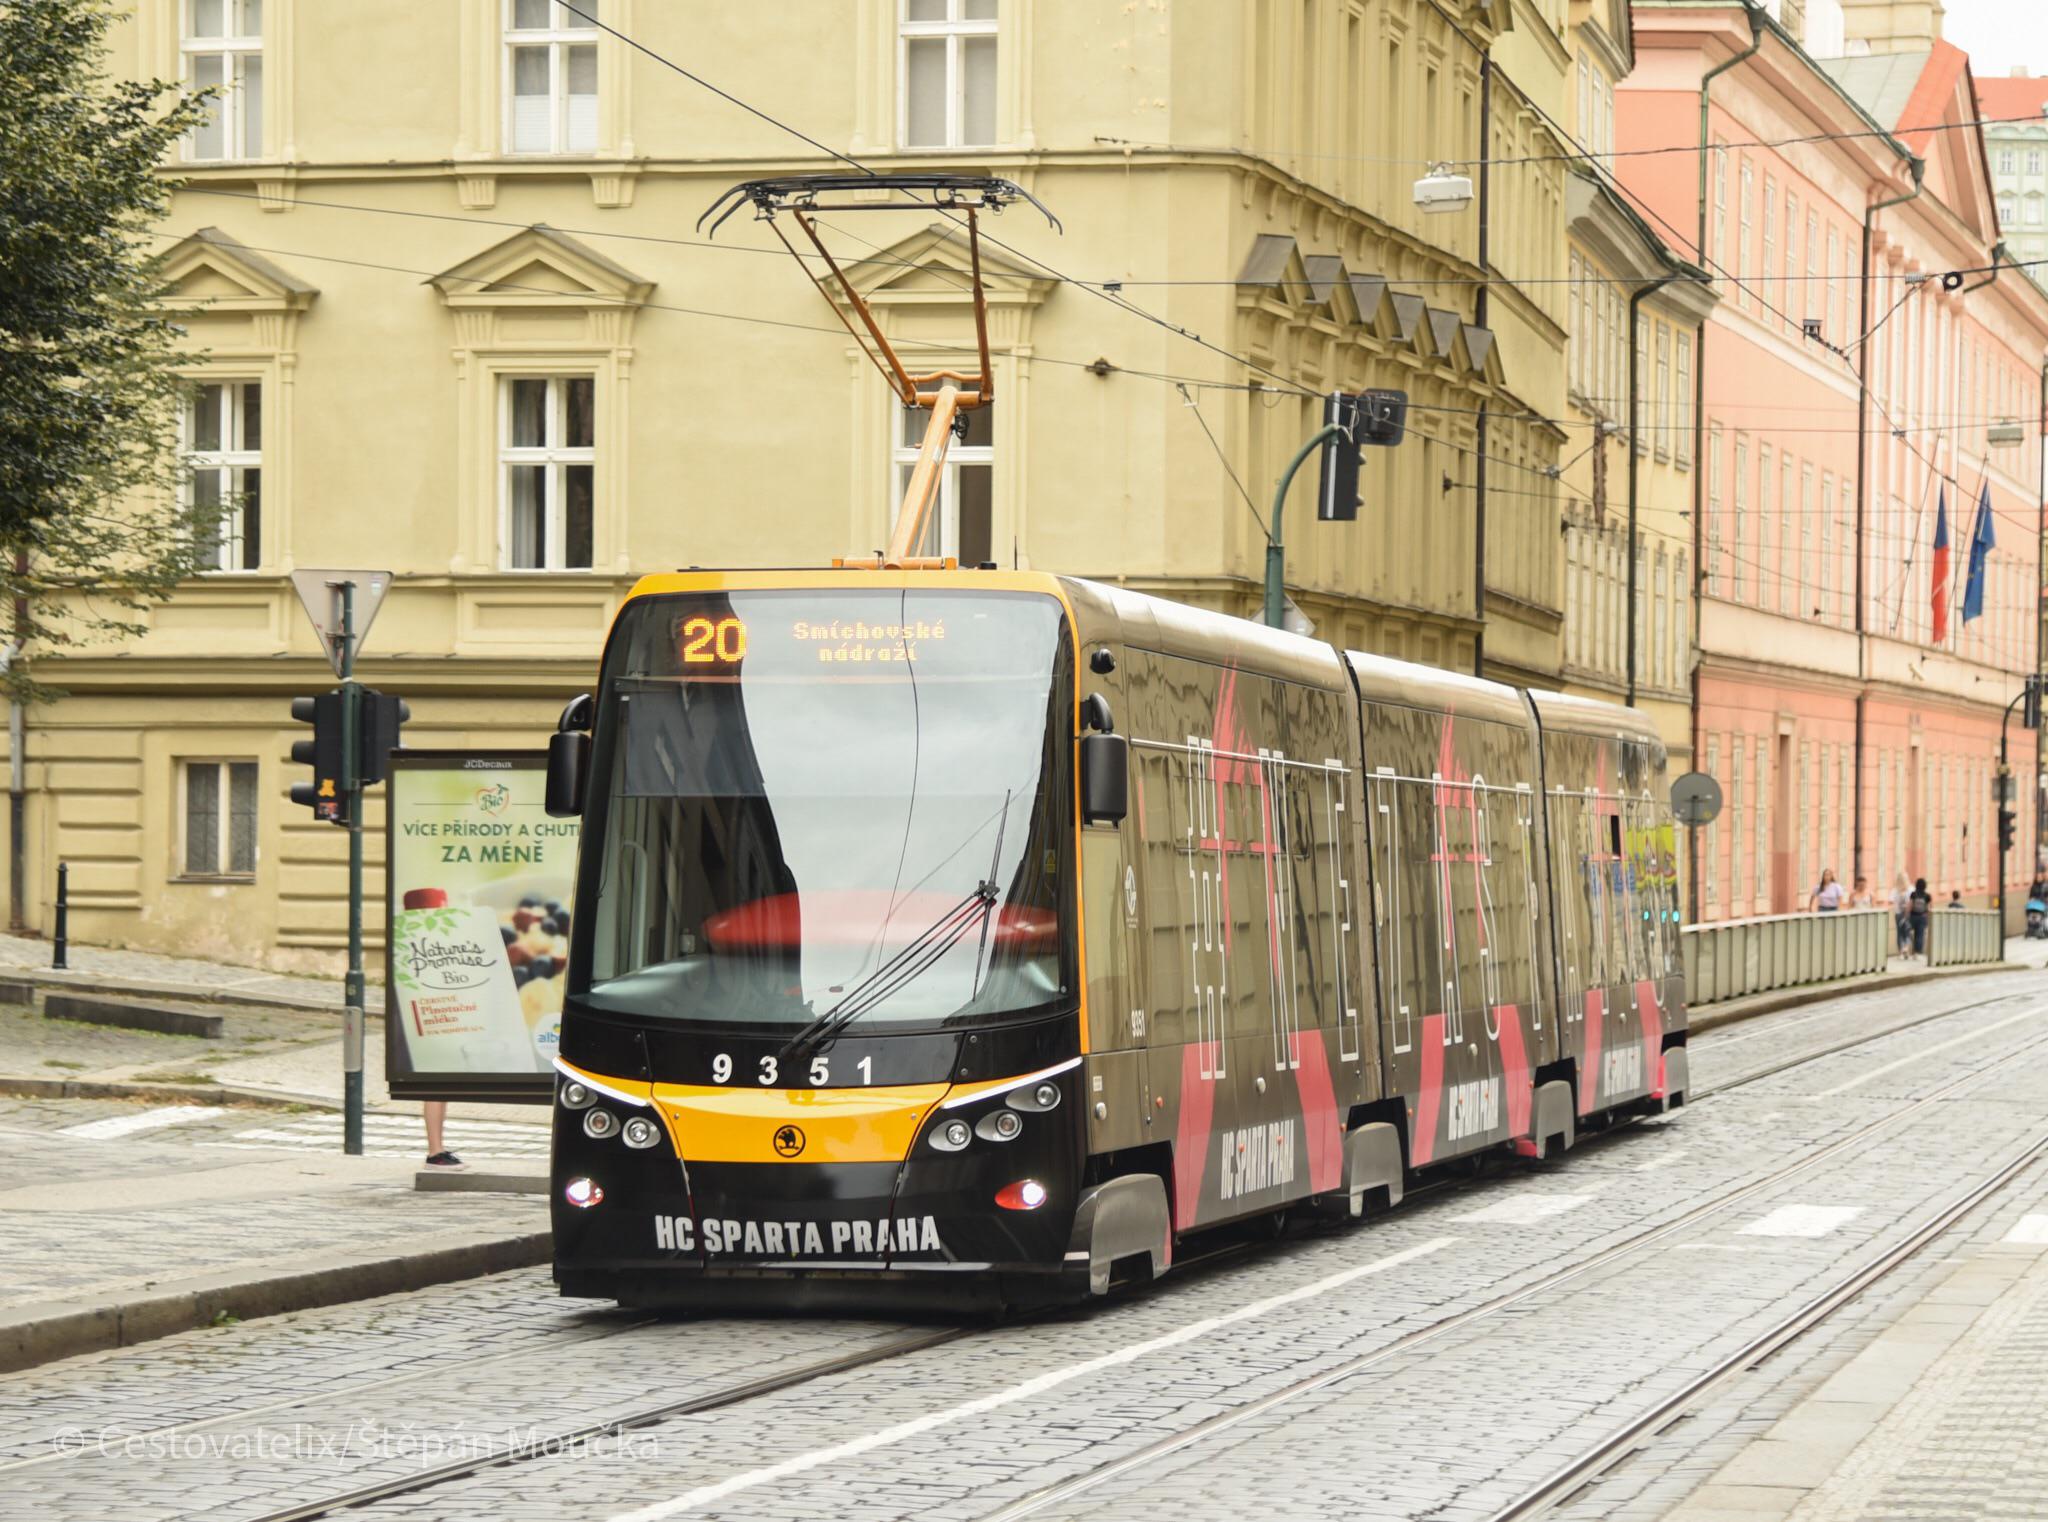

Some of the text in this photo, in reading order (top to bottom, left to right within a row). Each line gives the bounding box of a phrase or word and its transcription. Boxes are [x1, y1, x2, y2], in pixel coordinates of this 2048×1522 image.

[684, 618, 945, 661] 20 Smíchovské
[819, 641, 917, 661] nádraží
[464, 760, 512, 768] JCDecaux
[404, 820, 437, 836] VÍCE
[443, 819, 513, 836] PŘÍRODY
[518, 824, 529, 836] A
[442, 841, 543, 863] ZA MÉNĚ
[410, 937, 485, 959] Nature's
[408, 956, 497, 977] Promise
[442, 971, 469, 984] Bio
[654, 1215, 941, 1254] HC SPARTA PRAHA
